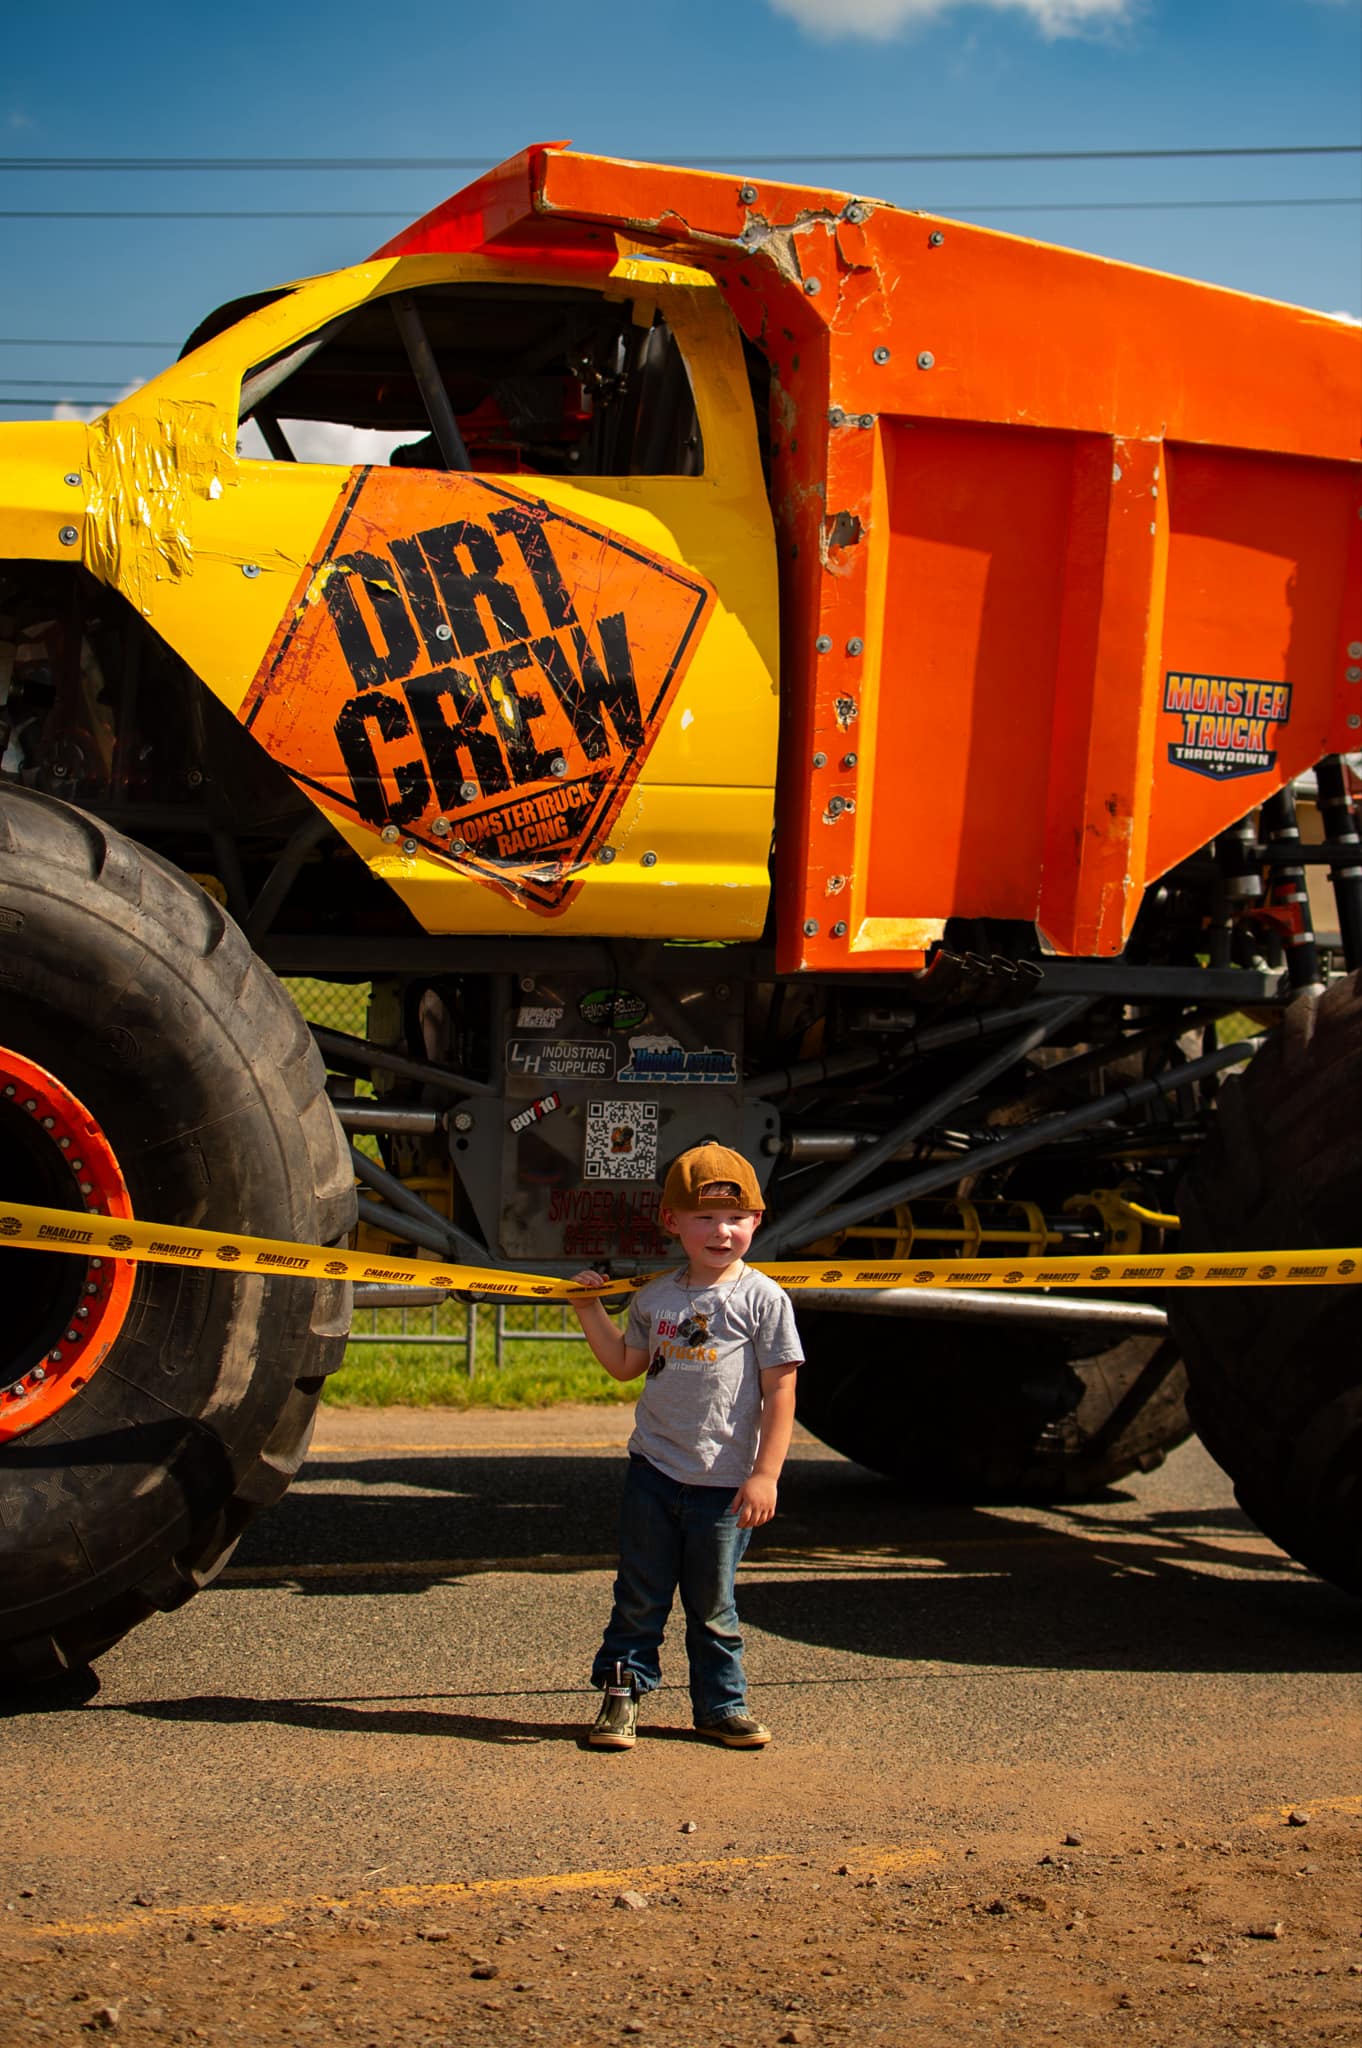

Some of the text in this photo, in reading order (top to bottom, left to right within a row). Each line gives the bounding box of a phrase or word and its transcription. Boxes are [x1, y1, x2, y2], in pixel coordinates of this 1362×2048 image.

[321, 500, 578, 692] DIRT
[1166, 676, 1289, 718] MONSTER
[333, 612, 645, 827] CREW
[1184, 713, 1266, 752] TRUCK
[1175, 747, 1270, 766] THROWDOWN
[496, 815, 569, 858] RACING
[541, 1046, 612, 1060] INDUSTRIAL
[549, 1061, 606, 1074] SUPPLIES
[509, 1106, 537, 1133] BUY
[38, 1224, 94, 1242] CHARLOTTE
[148, 1241, 203, 1258] CHARLOTTE
[256, 1252, 311, 1268] CHARLOTTE
[363, 1267, 417, 1281] CHARLOTTE
[468, 1281, 520, 1293] CHARLOTTE
[657, 1319, 677, 1339] Big
